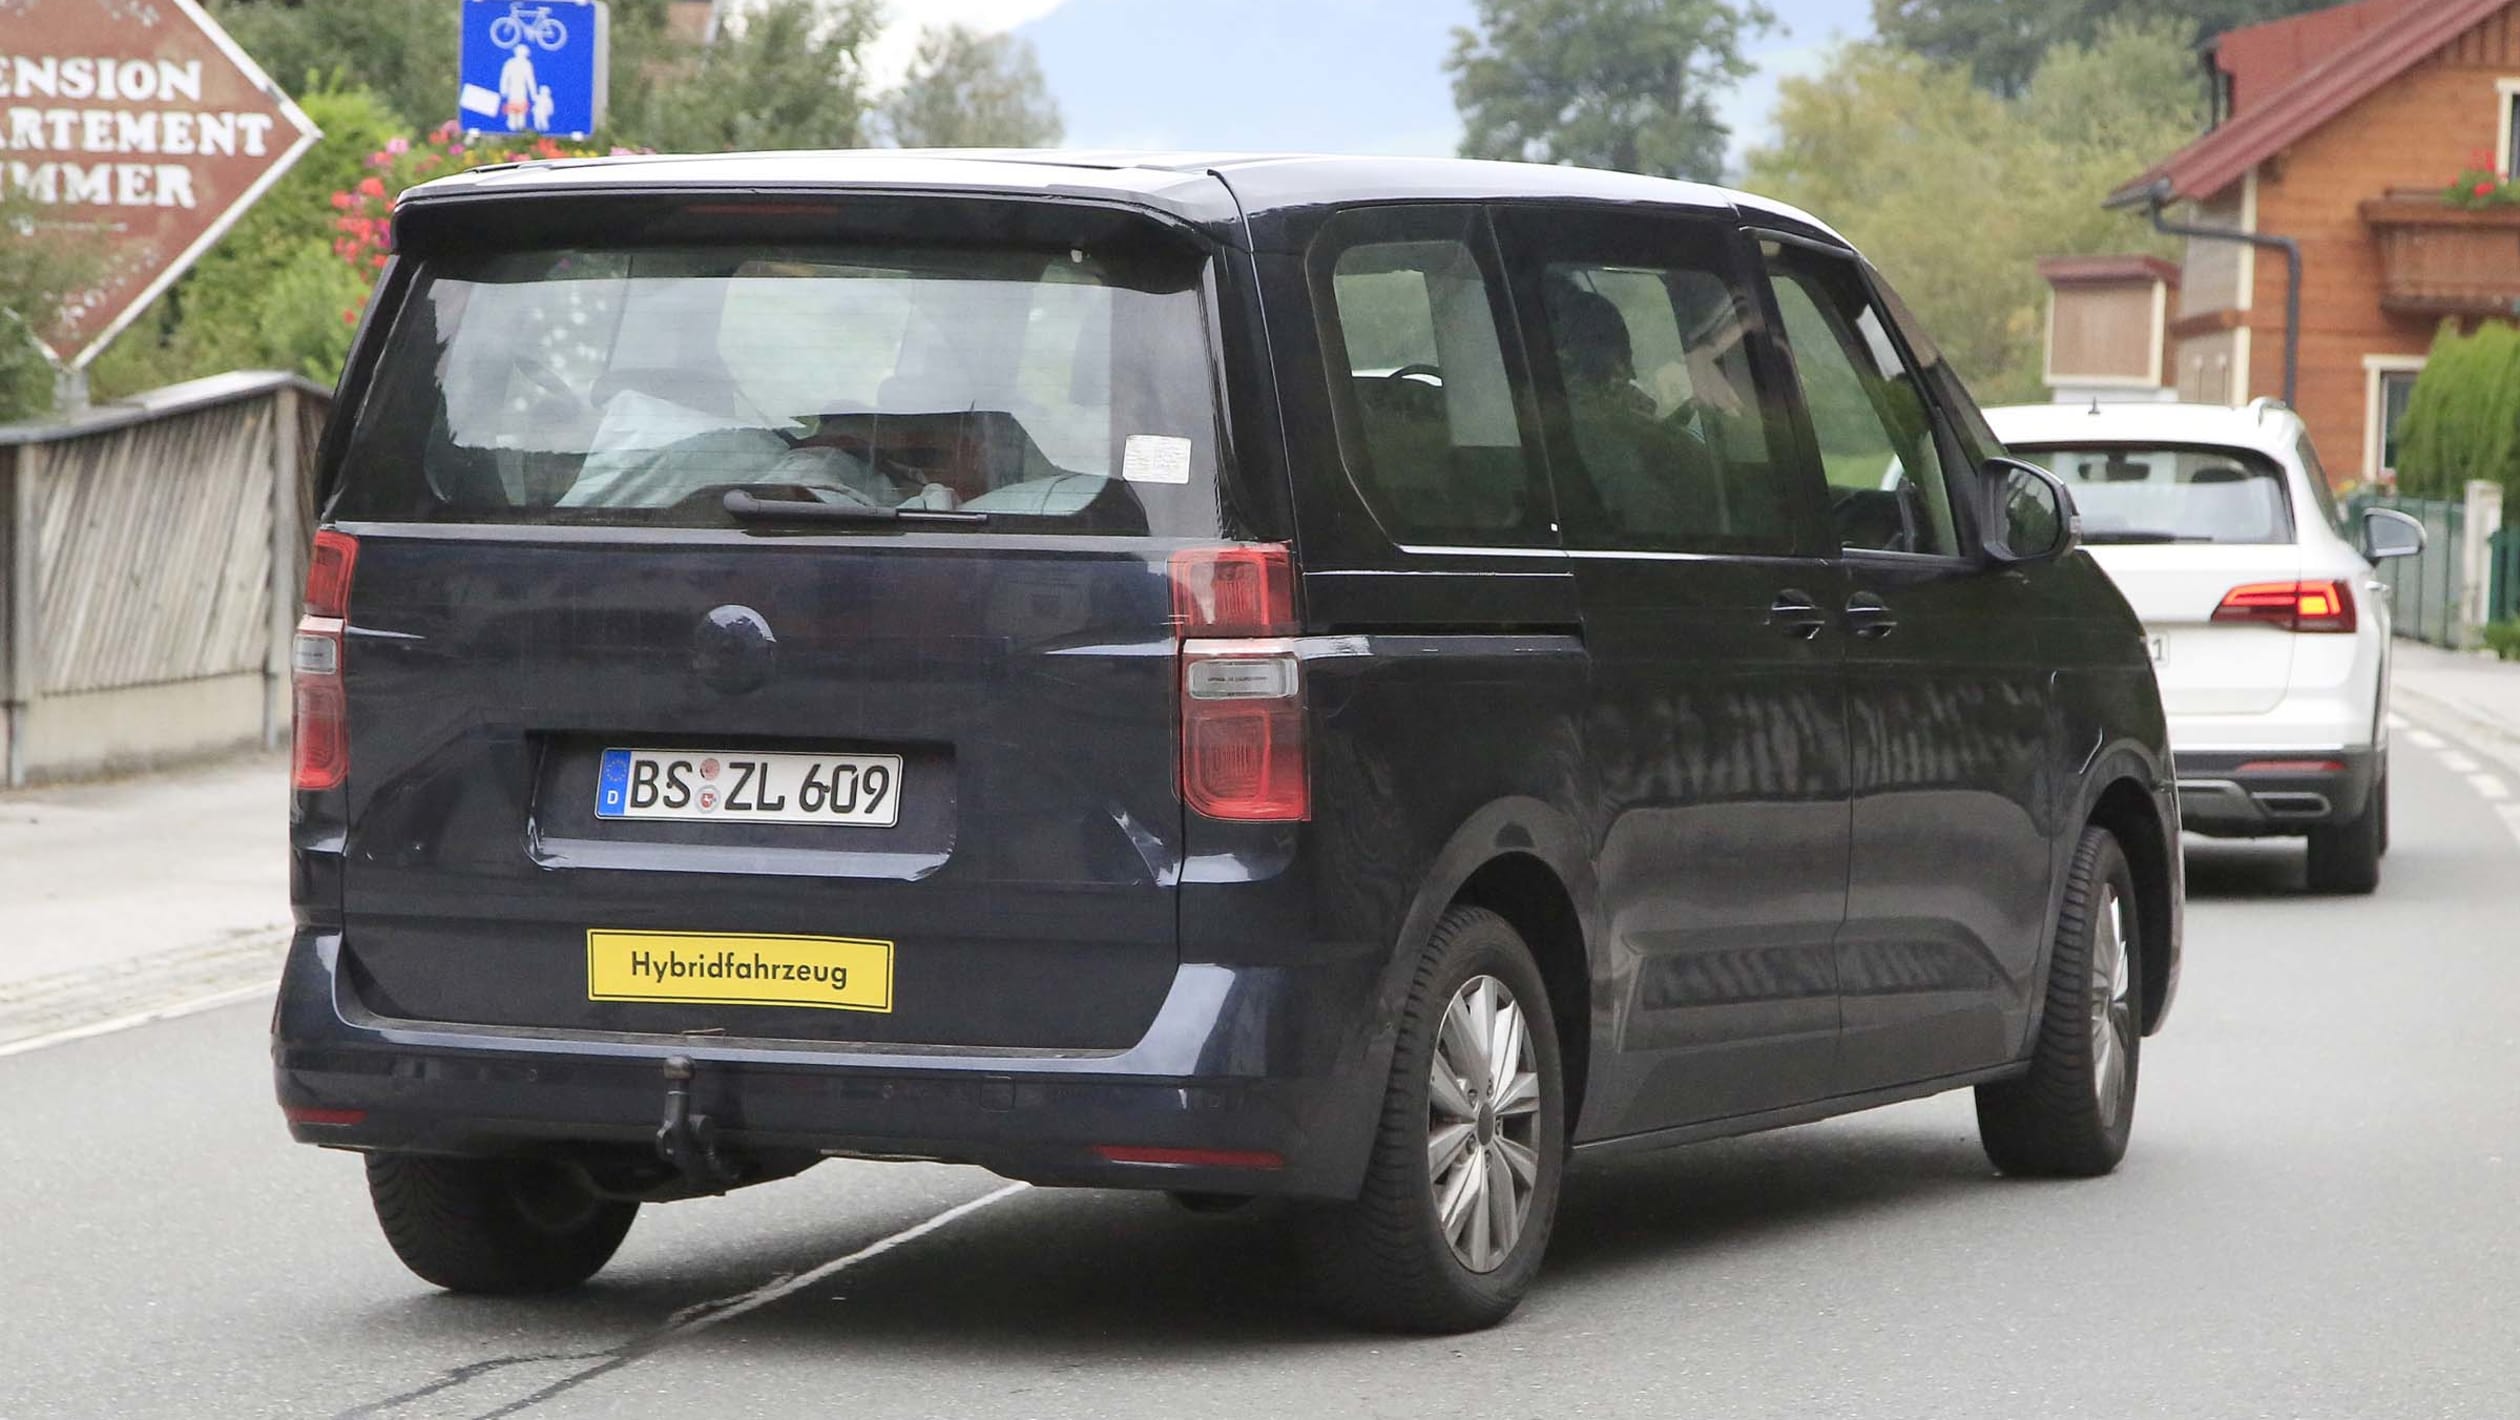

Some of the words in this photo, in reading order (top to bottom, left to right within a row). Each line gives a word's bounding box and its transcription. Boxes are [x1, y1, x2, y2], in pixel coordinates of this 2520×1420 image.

[0, 106, 273, 156] RTEMENT
[607, 790, 619, 805] D
[630, 760, 693, 808] BS
[724, 762, 786, 811] ZL
[799, 764, 890, 814] 609
[631, 951, 848, 990] Hybridfahrzeug
